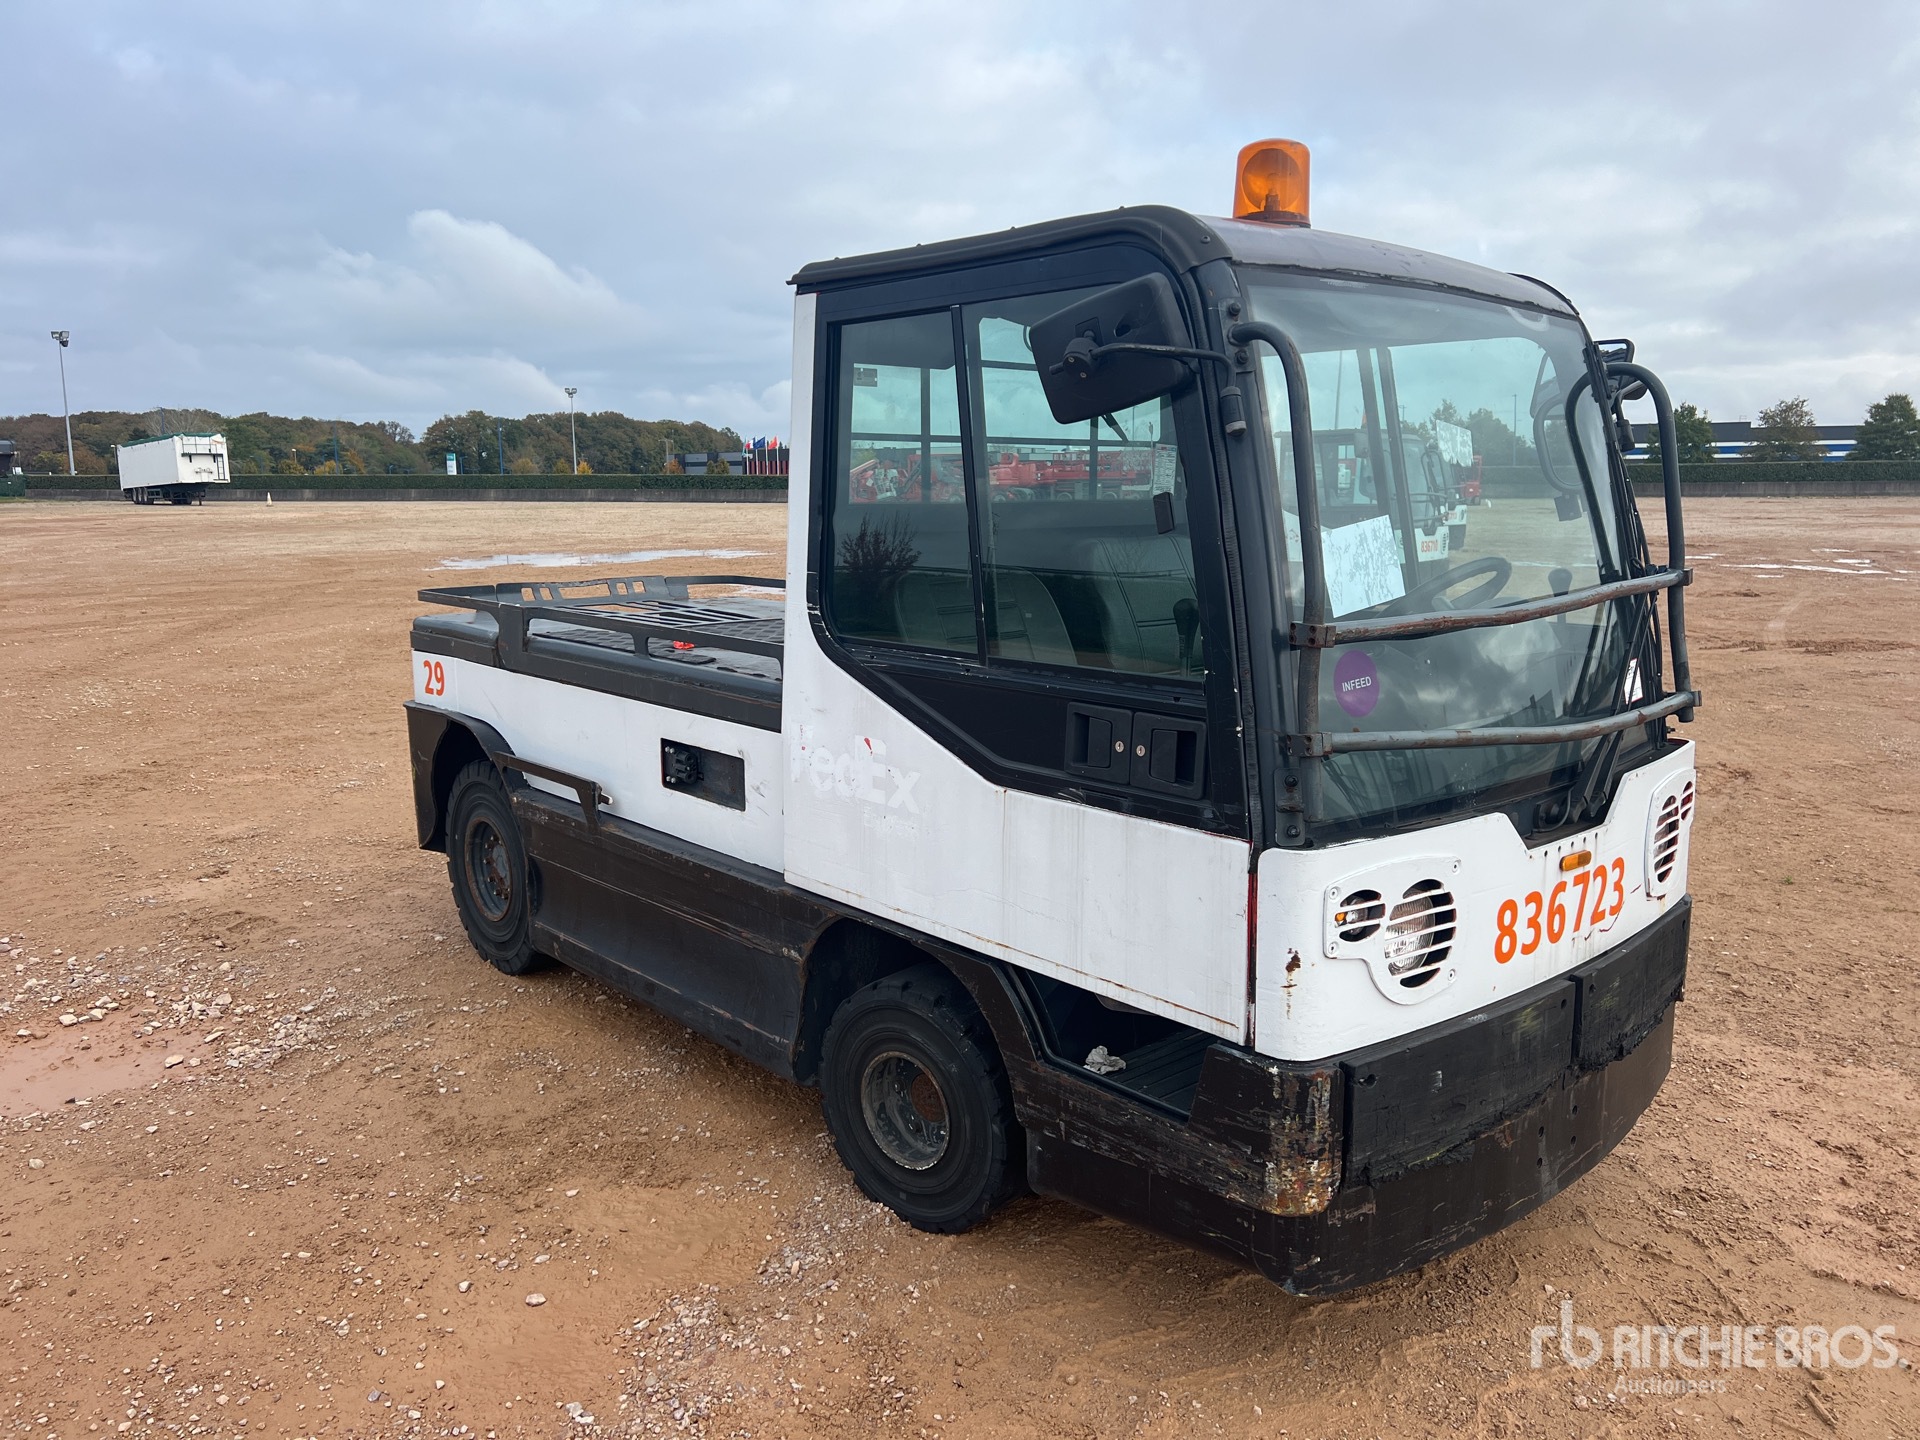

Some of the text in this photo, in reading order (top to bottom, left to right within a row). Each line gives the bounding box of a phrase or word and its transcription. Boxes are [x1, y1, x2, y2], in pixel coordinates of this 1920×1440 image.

[423, 660, 445, 697] 29
[1342, 676, 1372, 692] INFEED
[1494, 856, 1625, 964] 836723
